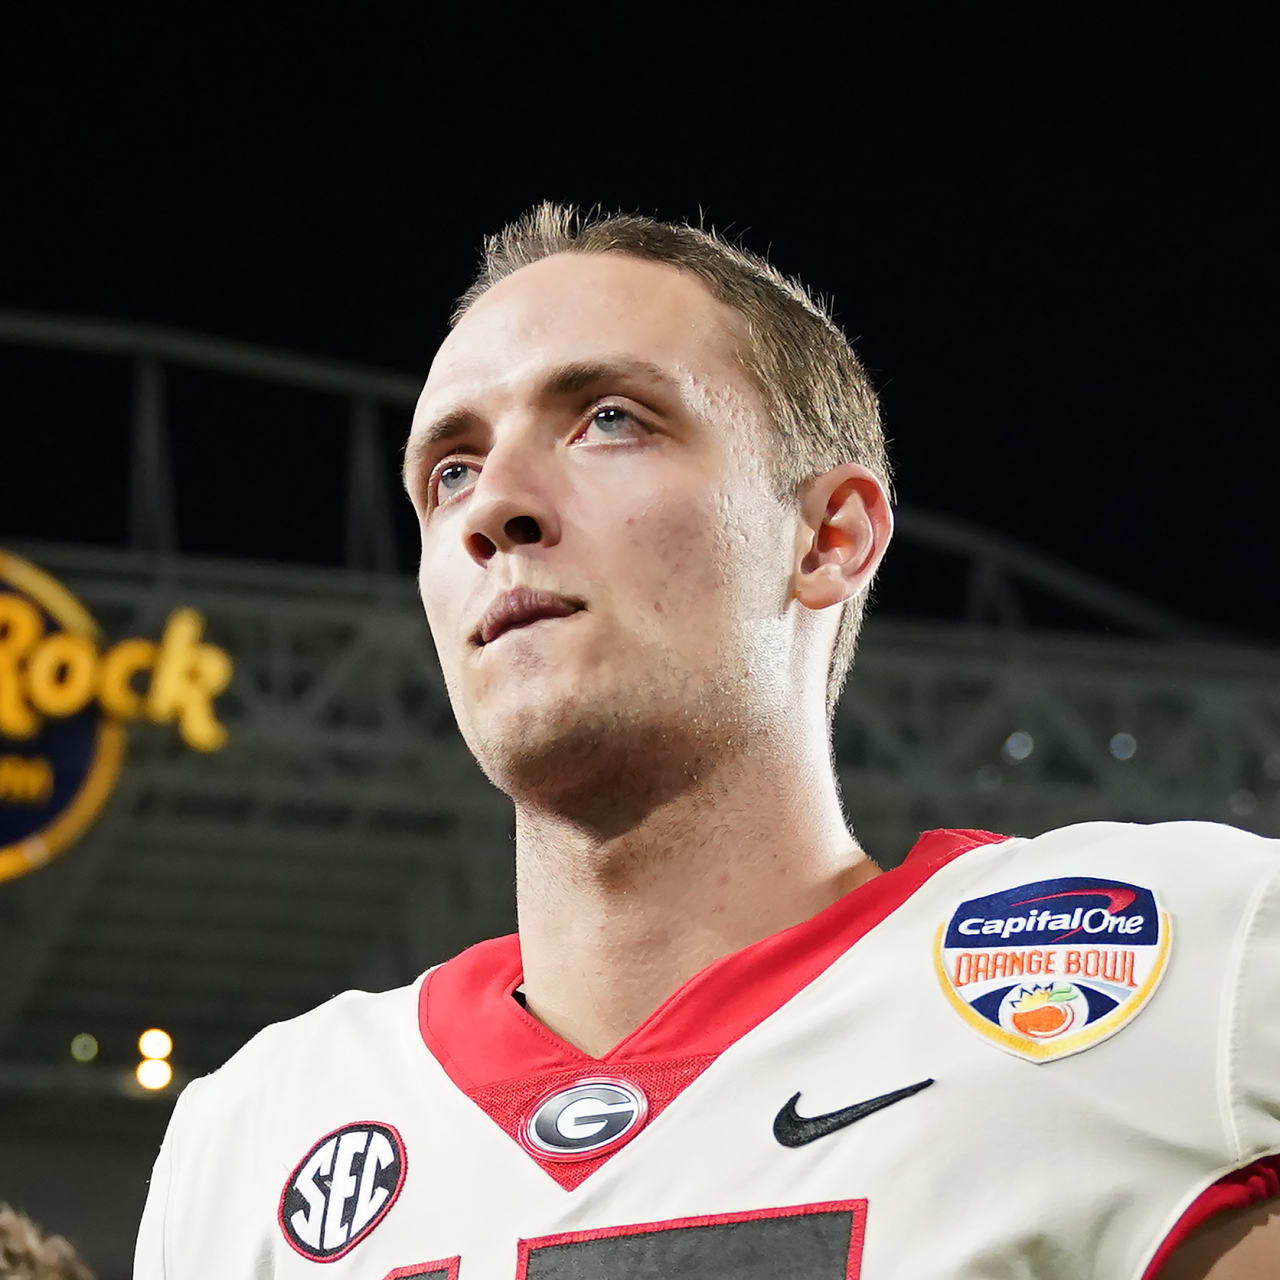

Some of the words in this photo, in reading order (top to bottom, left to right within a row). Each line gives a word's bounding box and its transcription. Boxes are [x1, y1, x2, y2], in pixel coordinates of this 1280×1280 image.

[954, 951, 1056, 987] ORANGE
[1064, 949, 1138, 988] BOWL
[292, 1131, 396, 1250] SEC
